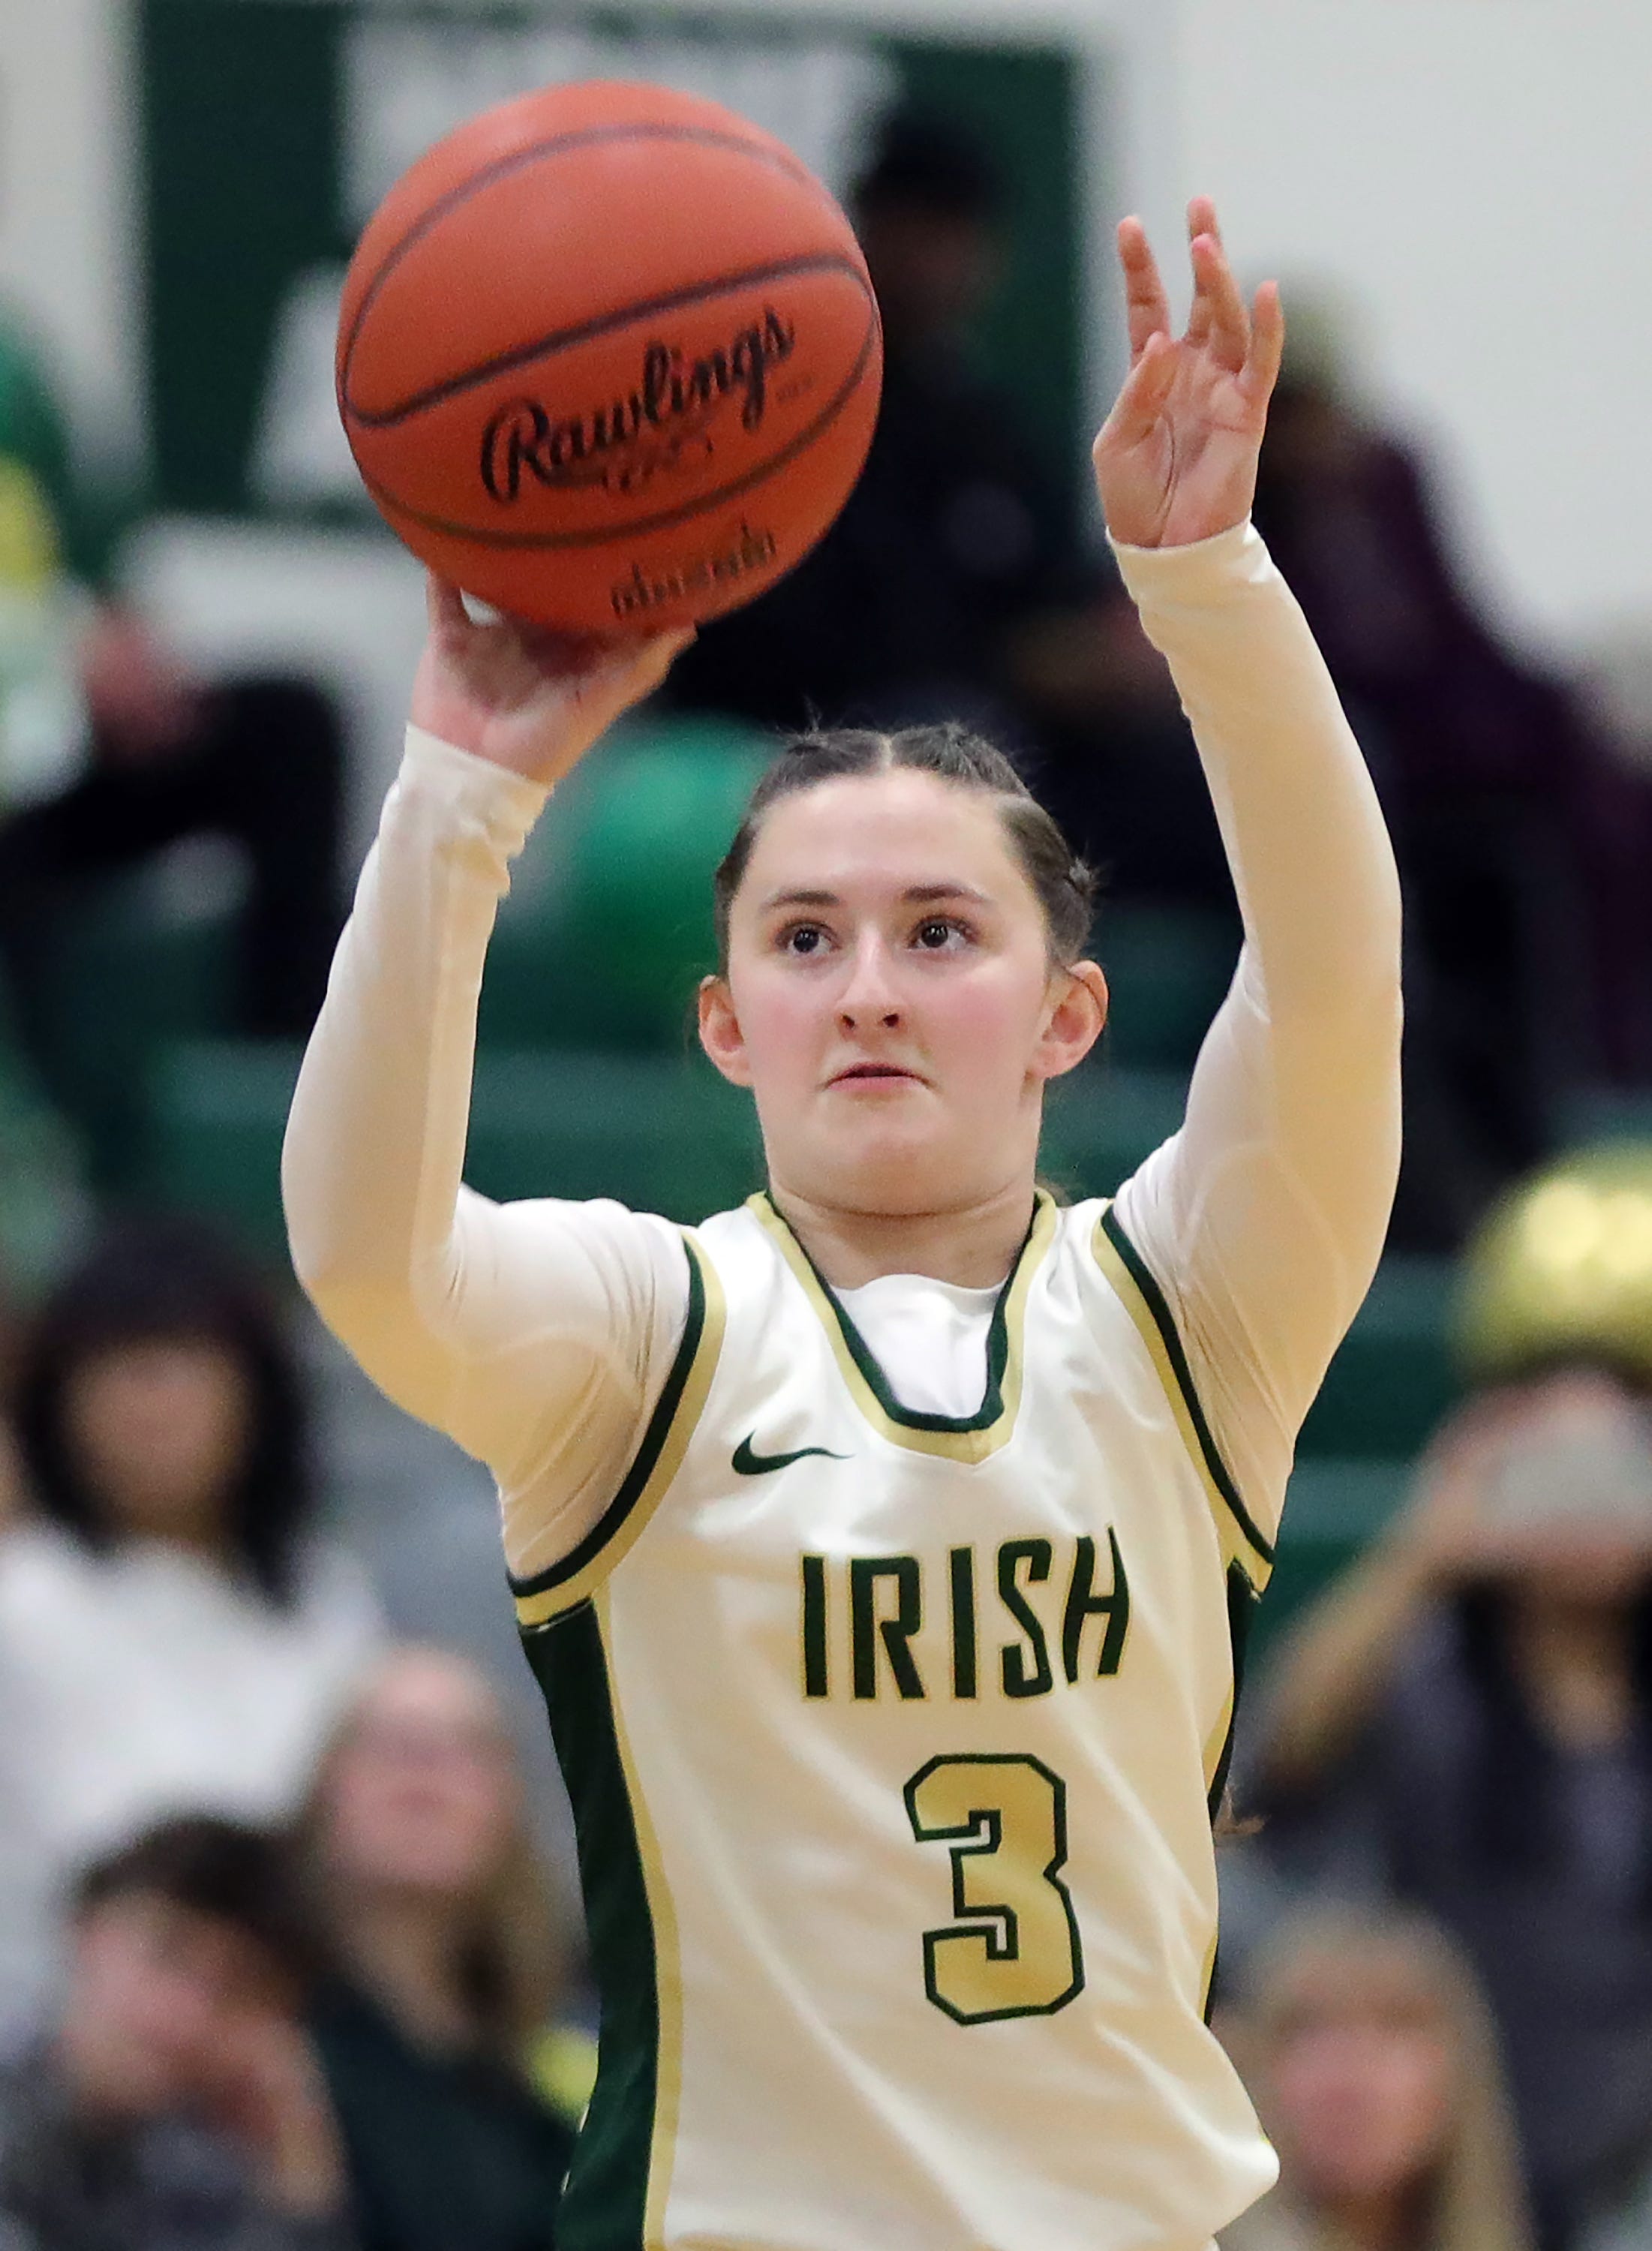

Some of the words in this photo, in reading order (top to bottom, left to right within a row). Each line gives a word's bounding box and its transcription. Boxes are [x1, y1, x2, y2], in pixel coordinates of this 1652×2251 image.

[480, 306, 794, 504] Rawlings
[800, 1525, 1131, 1702] IRISH
[903, 1753, 1086, 2027] 3
